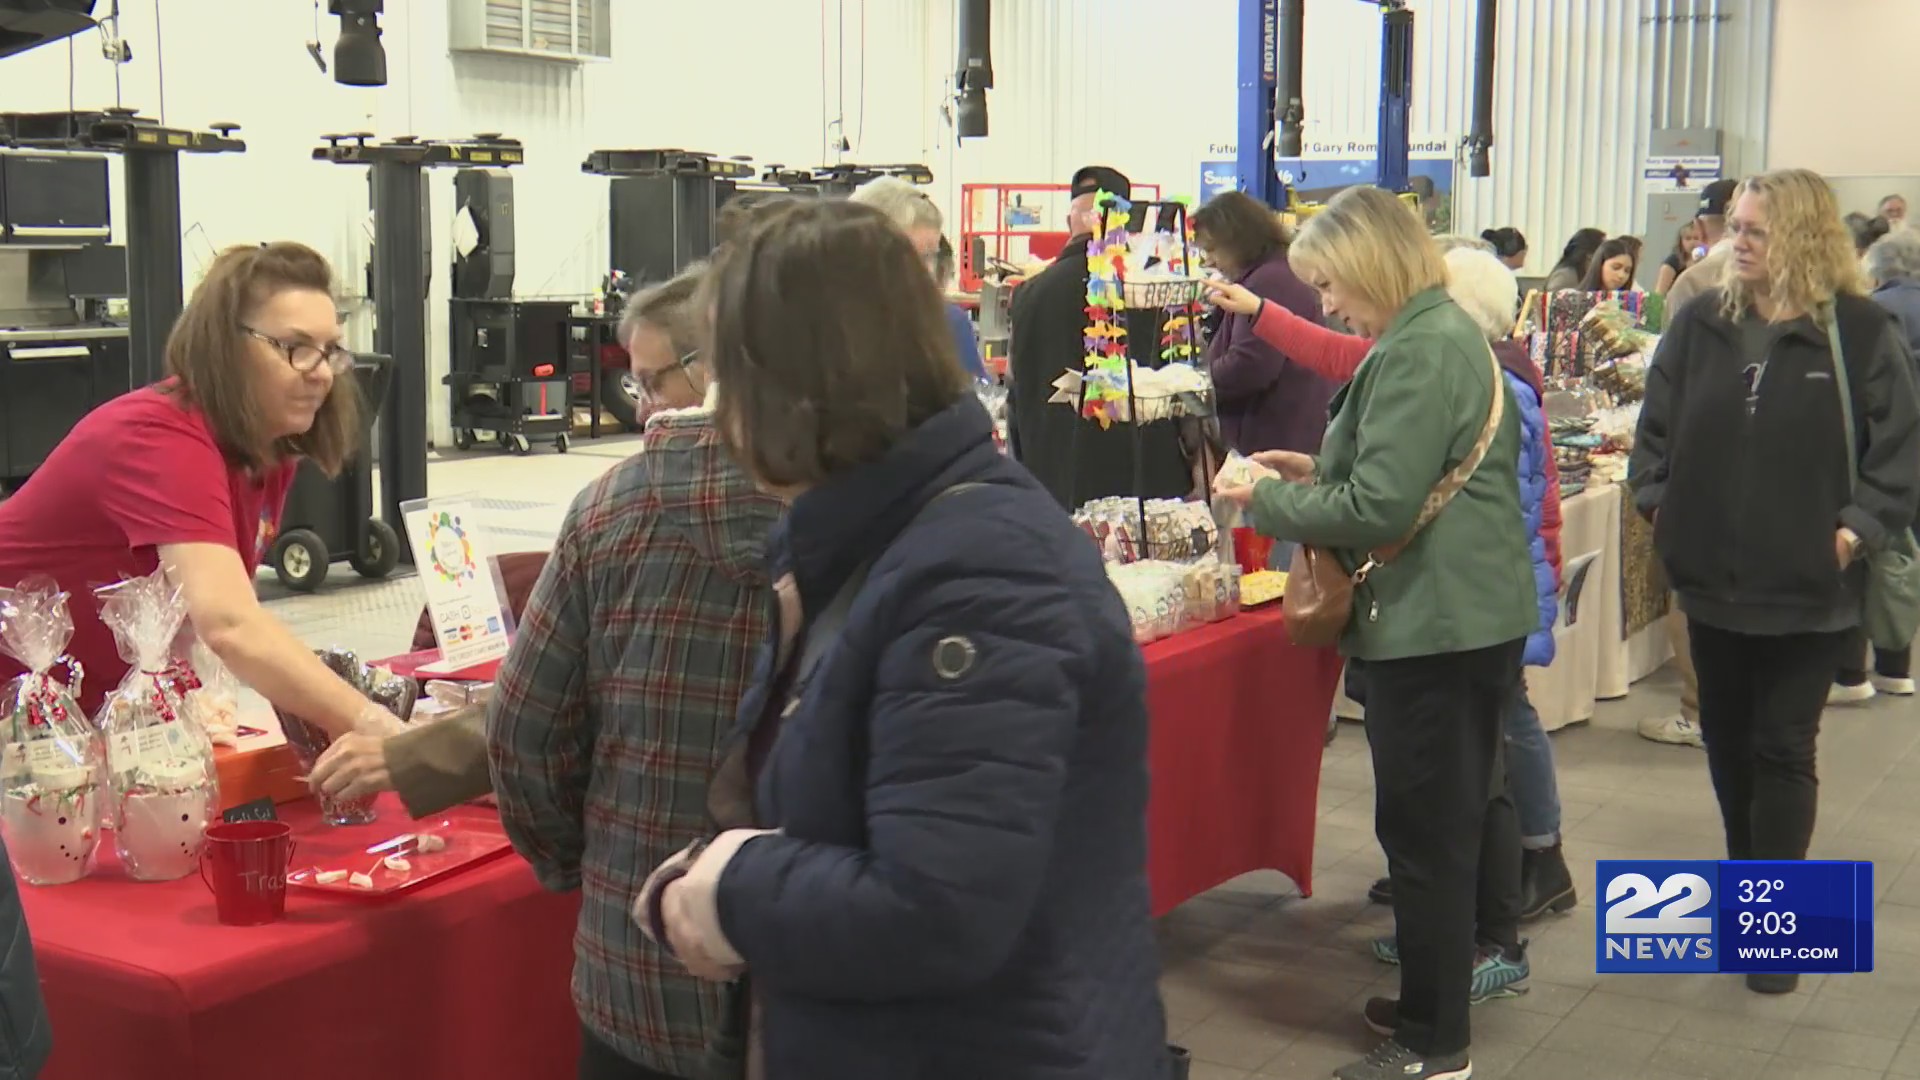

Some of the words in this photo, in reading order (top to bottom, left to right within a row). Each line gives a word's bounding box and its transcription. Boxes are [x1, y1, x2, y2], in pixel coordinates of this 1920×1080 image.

[1264, 14, 1274, 72] ROTARY
[1209, 144, 1237, 154] Futu
[1313, 142, 1343, 154] Gary
[1348, 142, 1377, 152] Rom
[1408, 140, 1447, 152] undai
[237, 870, 287, 892] Tras
